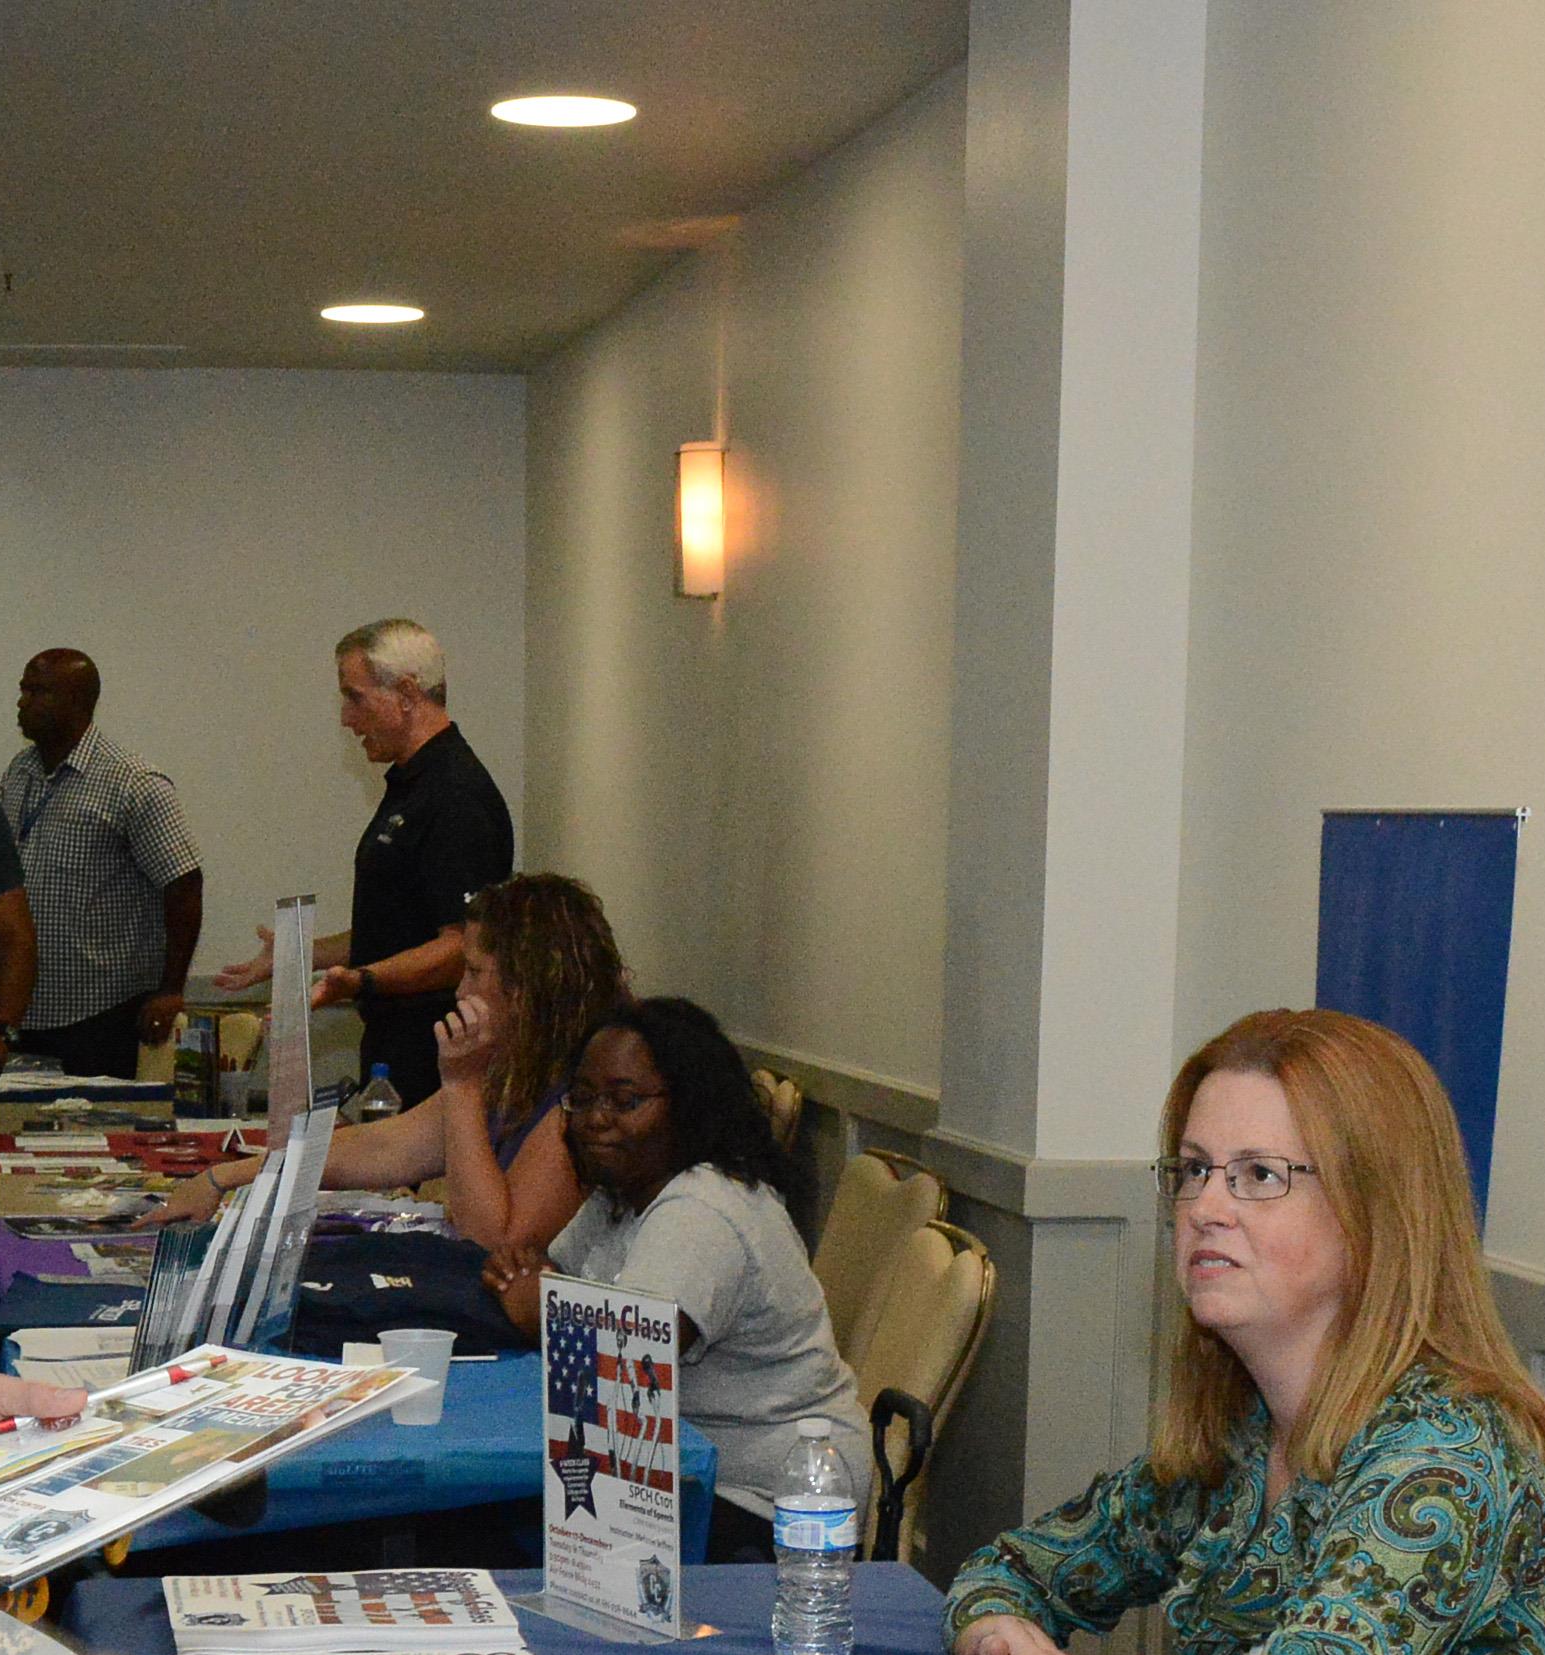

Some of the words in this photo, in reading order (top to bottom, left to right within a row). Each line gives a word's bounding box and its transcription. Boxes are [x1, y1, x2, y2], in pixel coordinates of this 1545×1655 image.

[547, 1288, 615, 1333] Speech
[622, 1304, 671, 1345] Class
[265, 1382, 339, 1399] FOR
[629, 1483, 652, 1504] SPCH
[654, 1491, 672, 1510] C101
[654, 1510, 673, 1523] Speech
[463, 1601, 494, 1623] Class
